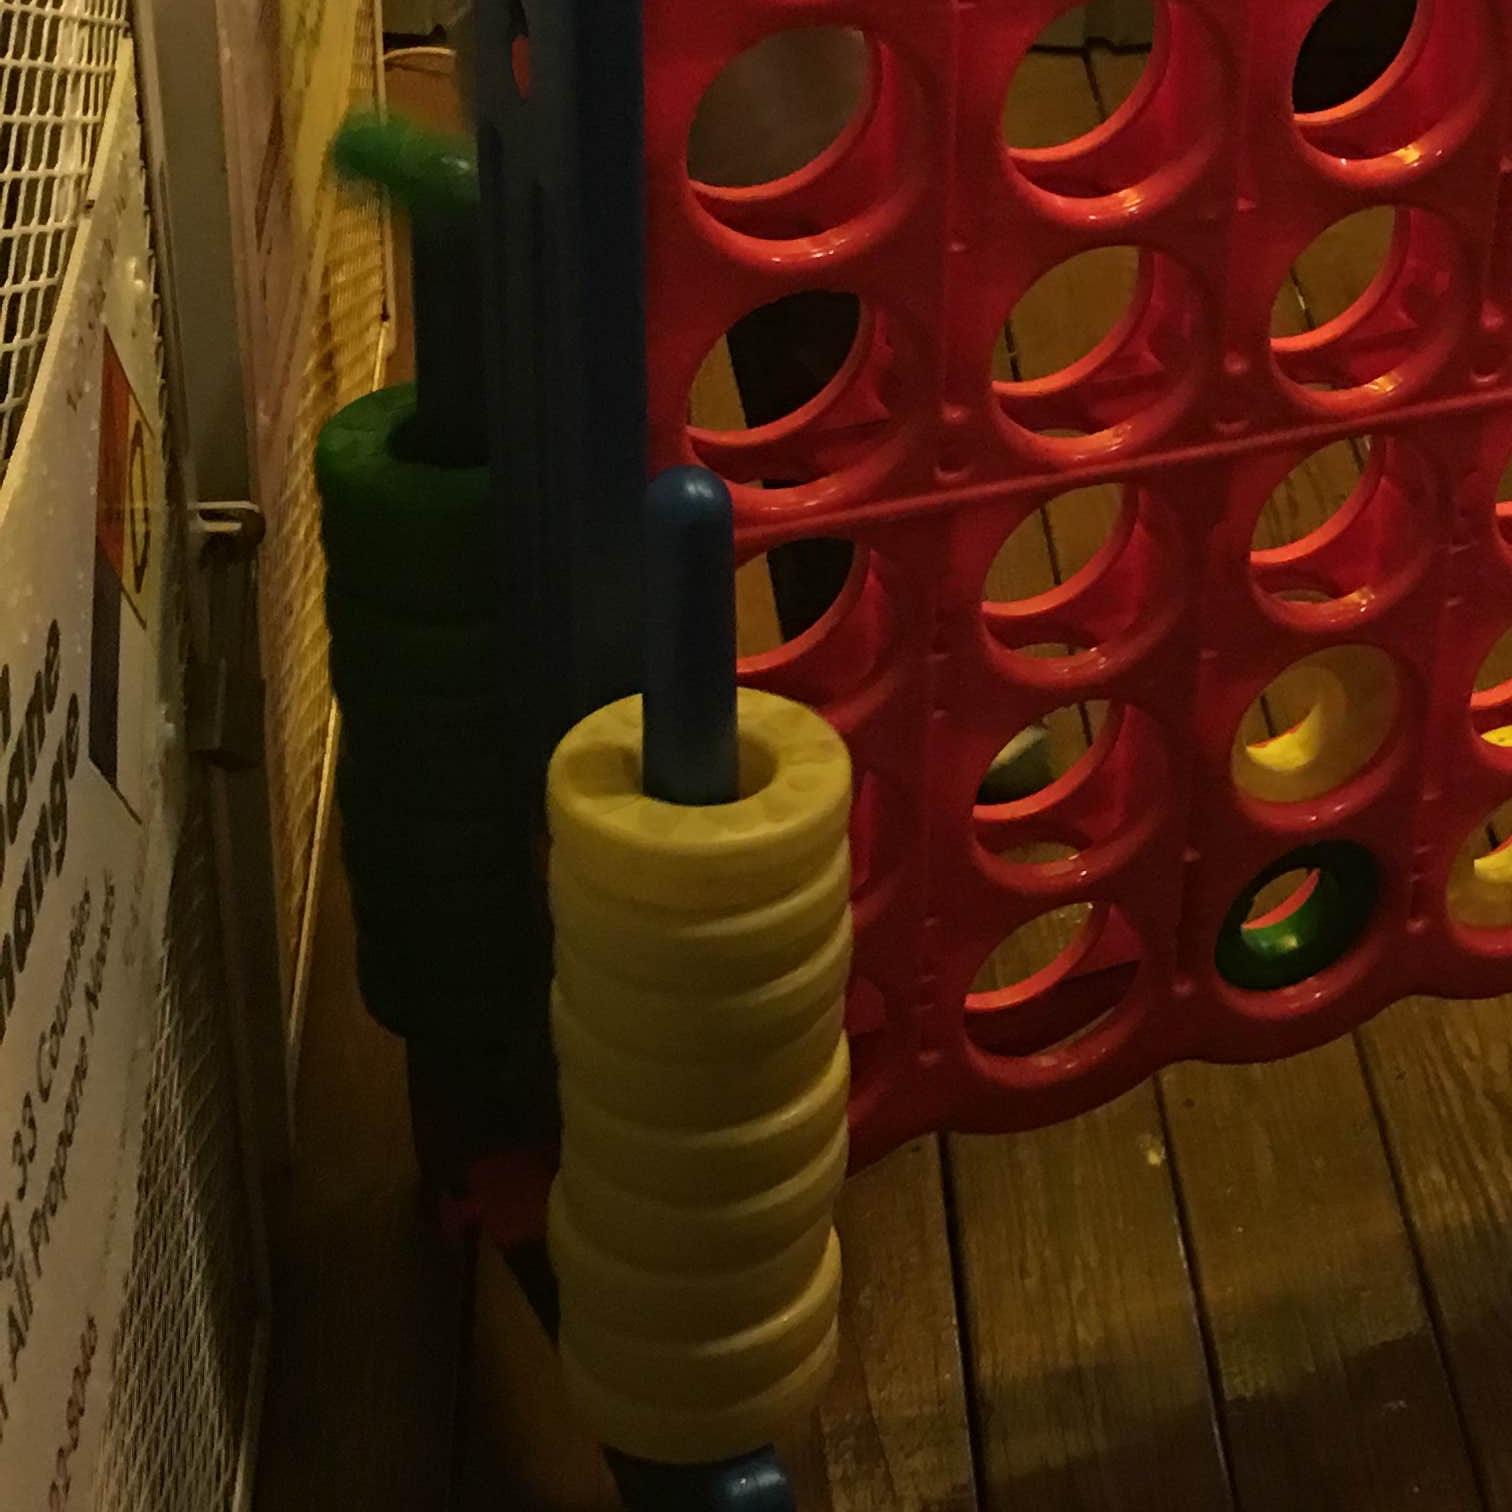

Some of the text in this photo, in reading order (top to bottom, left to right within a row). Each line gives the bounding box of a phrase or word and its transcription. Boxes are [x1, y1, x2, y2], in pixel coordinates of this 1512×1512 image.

[12, 876, 90, 1202] 33 Counties
[7, 1252, 33, 1382] All
[29, 1035, 88, 1277] Propane
